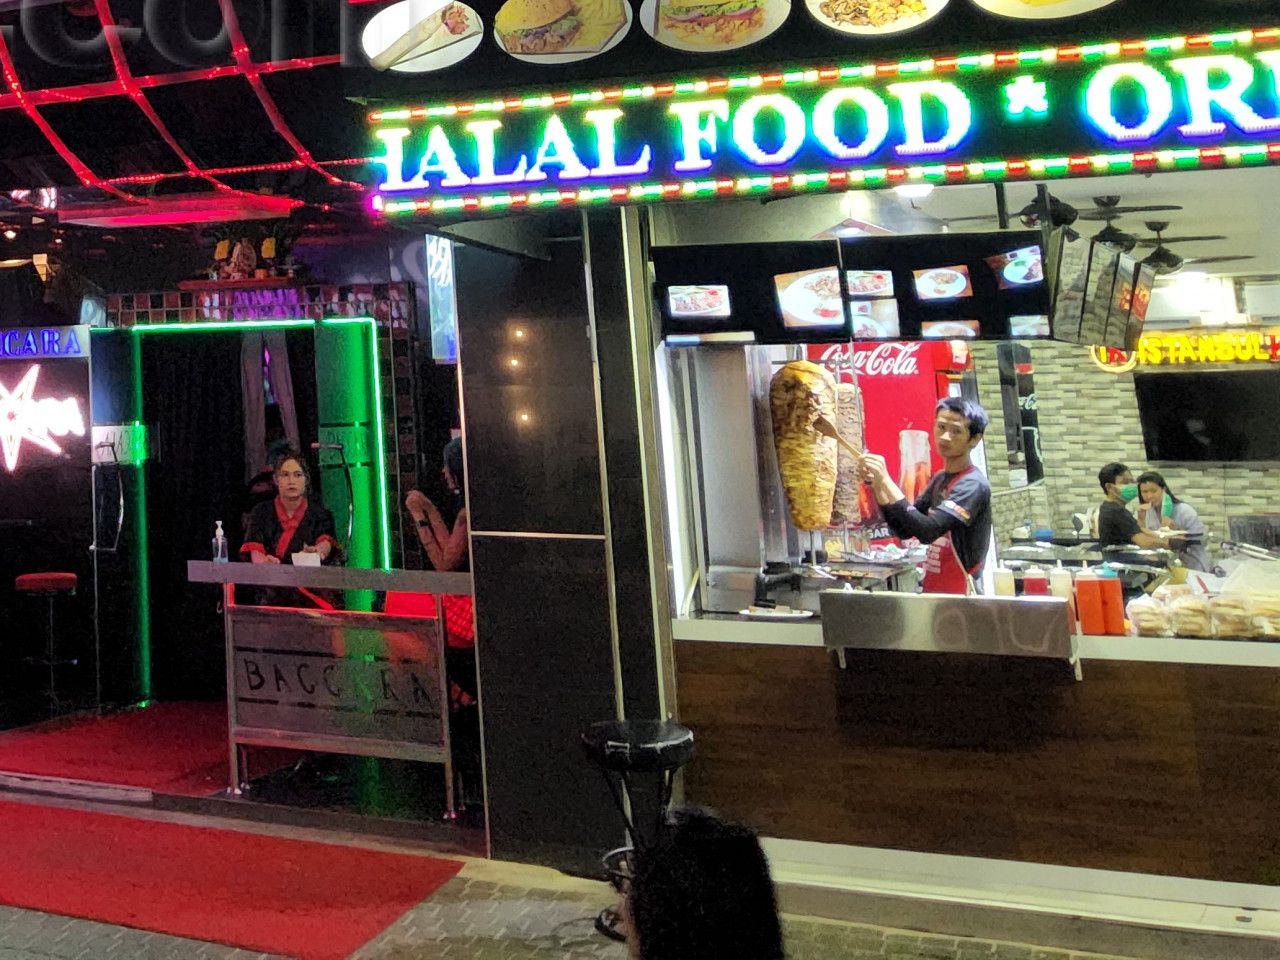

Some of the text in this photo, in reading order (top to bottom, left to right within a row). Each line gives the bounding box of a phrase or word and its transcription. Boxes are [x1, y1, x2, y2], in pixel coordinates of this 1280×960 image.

[669, 77, 973, 173] FOOD
[819, 342, 919, 377] Coca-Cola
[1138, 331, 1270, 365] ISTANBUL
